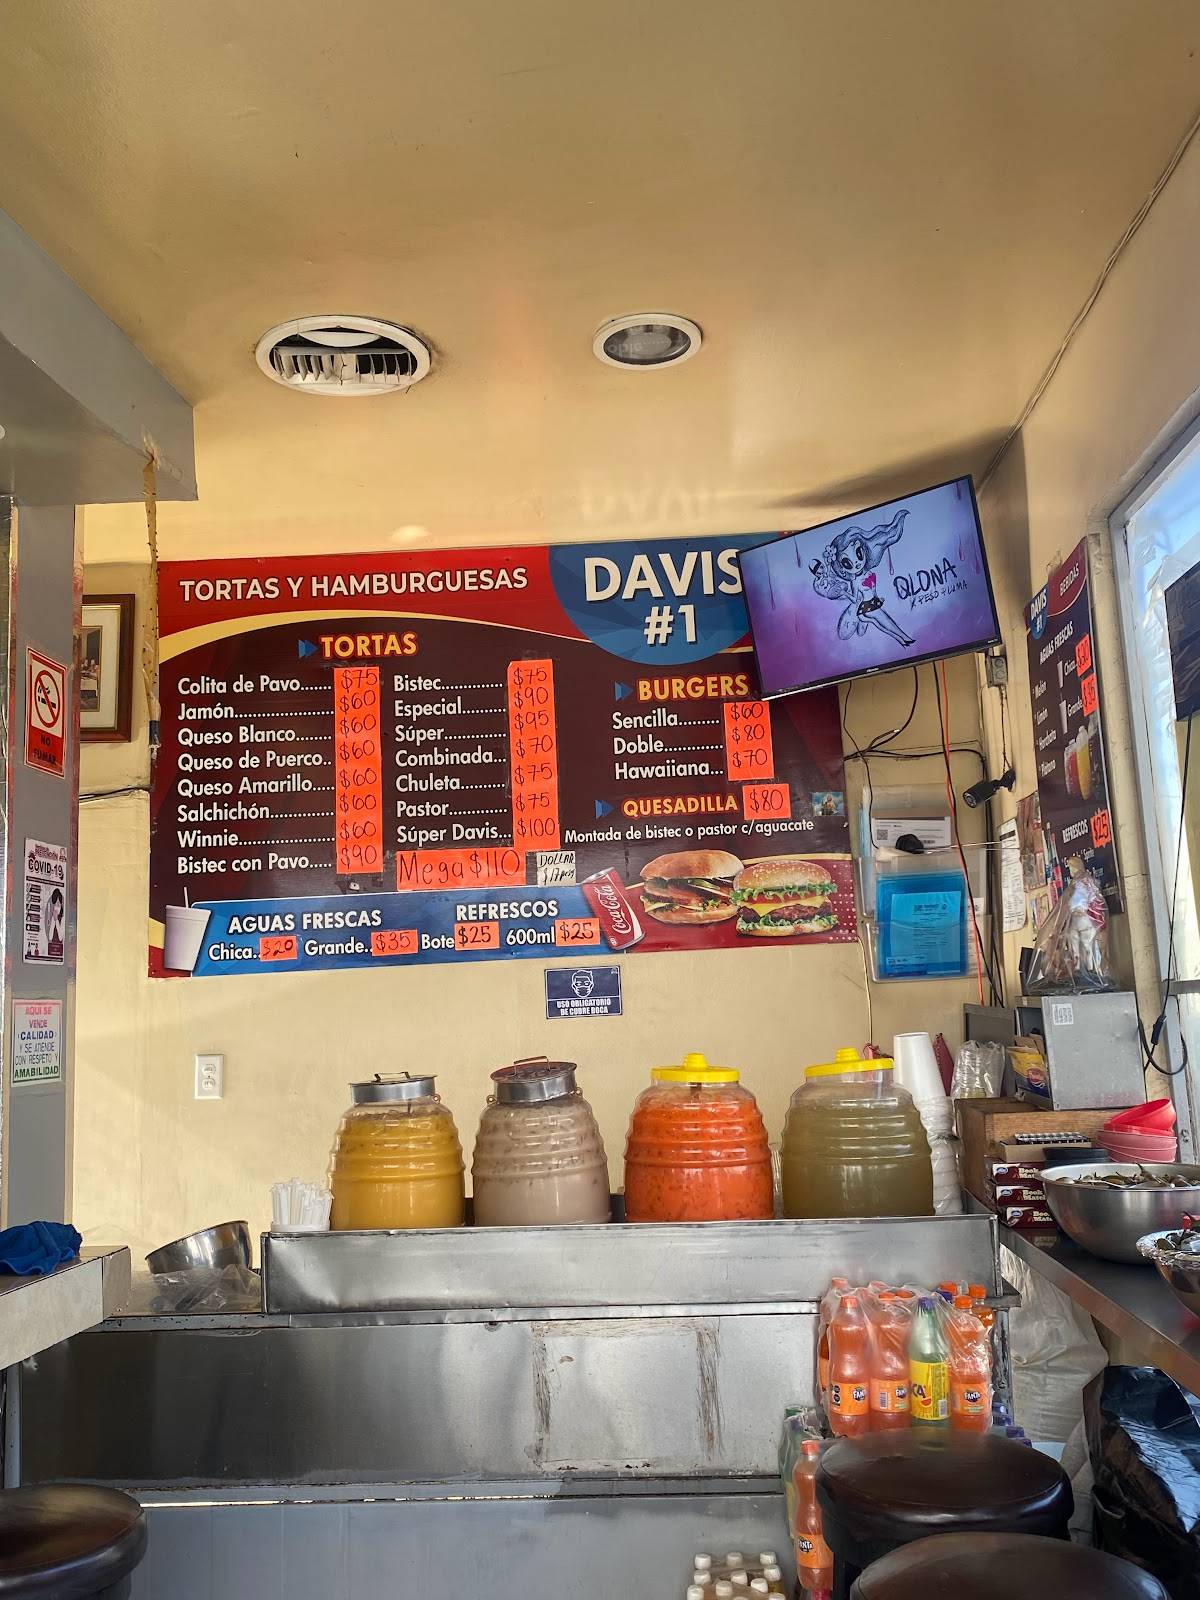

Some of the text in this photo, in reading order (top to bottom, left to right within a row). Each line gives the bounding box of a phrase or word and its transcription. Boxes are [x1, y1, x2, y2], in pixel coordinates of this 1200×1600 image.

[180, 567, 528, 602] TORTAS Y HAMBURGUESAS
[584, 548, 743, 602] DAVIS
[1060, 563, 1079, 596] BEBIDAS
[918, 590, 939, 604] PESO
[941, 579, 967, 596] PLUMA
[1030, 589, 1047, 620] DAVIS
[643, 604, 697, 645] #1
[1054, 621, 1073, 649] FRESCAS
[321, 633, 417, 658] TORTAS
[178, 675, 227, 696] Colita
[232, 675, 254, 694] de
[341, 668, 378, 692] $75
[513, 666, 548, 687] $75
[513, 687, 549, 709] $90
[638, 675, 749, 701] BURGERS
[339, 689, 376, 713] $60
[731, 702, 763, 720] $60
[339, 714, 377, 736] $60
[514, 711, 549, 734] $95
[178, 727, 233, 746] Queso
[731, 724, 765, 744] $80
[340, 739, 375, 761] $60
[516, 735, 553, 758] $70
[178, 753, 233, 772] Queso
[239, 750, 260, 769] de
[732, 748, 768, 769] $70
[340, 768, 377, 789] $60
[515, 762, 553, 786] $75
[178, 778, 233, 797] Queso
[340, 793, 376, 813] $60
[516, 792, 550, 812] $75
[623, 794, 738, 818] QUESADILLA
[749, 788, 784, 813] $80
[340, 820, 376, 841] $60
[397, 825, 446, 847] Súper
[517, 818, 555, 838] $100
[565, 827, 622, 843] Montada
[625, 825, 642, 840] de
[645, 823, 681, 839] bistec
[685, 828, 693, 837] o
[697, 822, 737, 843] pastor
[1062, 819, 1089, 843] REFRESCOS
[178, 855, 226, 874] Bistec
[232, 858, 261, 872] con
[340, 845, 377, 869] $90
[400, 850, 520, 885] Mega $110
[28, 859, 63, 878] COVID-19
[457, 900, 558, 921] REFRESCOS
[228, 910, 382, 934] AGUAS FRESCAS
[560, 922, 594, 942] $25
[375, 931, 411, 952] $35
[421, 933, 455, 950] Bote
[458, 926, 491, 947] $25
[506, 927, 555, 945] 600ml
[262, 939, 294, 958] $20
[557, 998, 611, 1008] USO OBLIGATORIO
[569, 1007, 590, 1015] CUBRE
[591, 1006, 608, 1014] BOCA
[14, 1066, 59, 1078] AMABILIDAD
